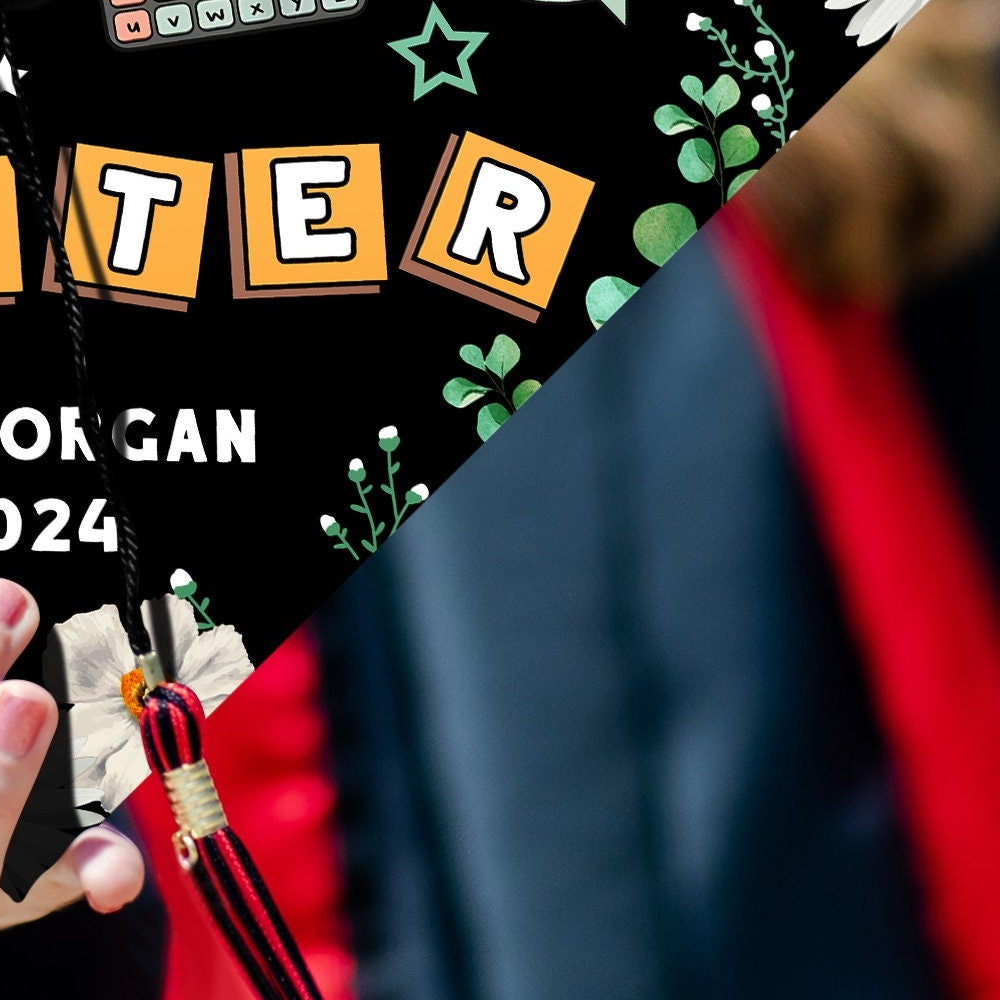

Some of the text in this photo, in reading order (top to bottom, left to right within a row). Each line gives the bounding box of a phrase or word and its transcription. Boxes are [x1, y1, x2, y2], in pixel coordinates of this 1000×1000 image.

[126, 21, 141, 33] u
[167, 15, 179, 28] v
[205, 8, 225, 22] w
[250, 2, 265, 16] x
